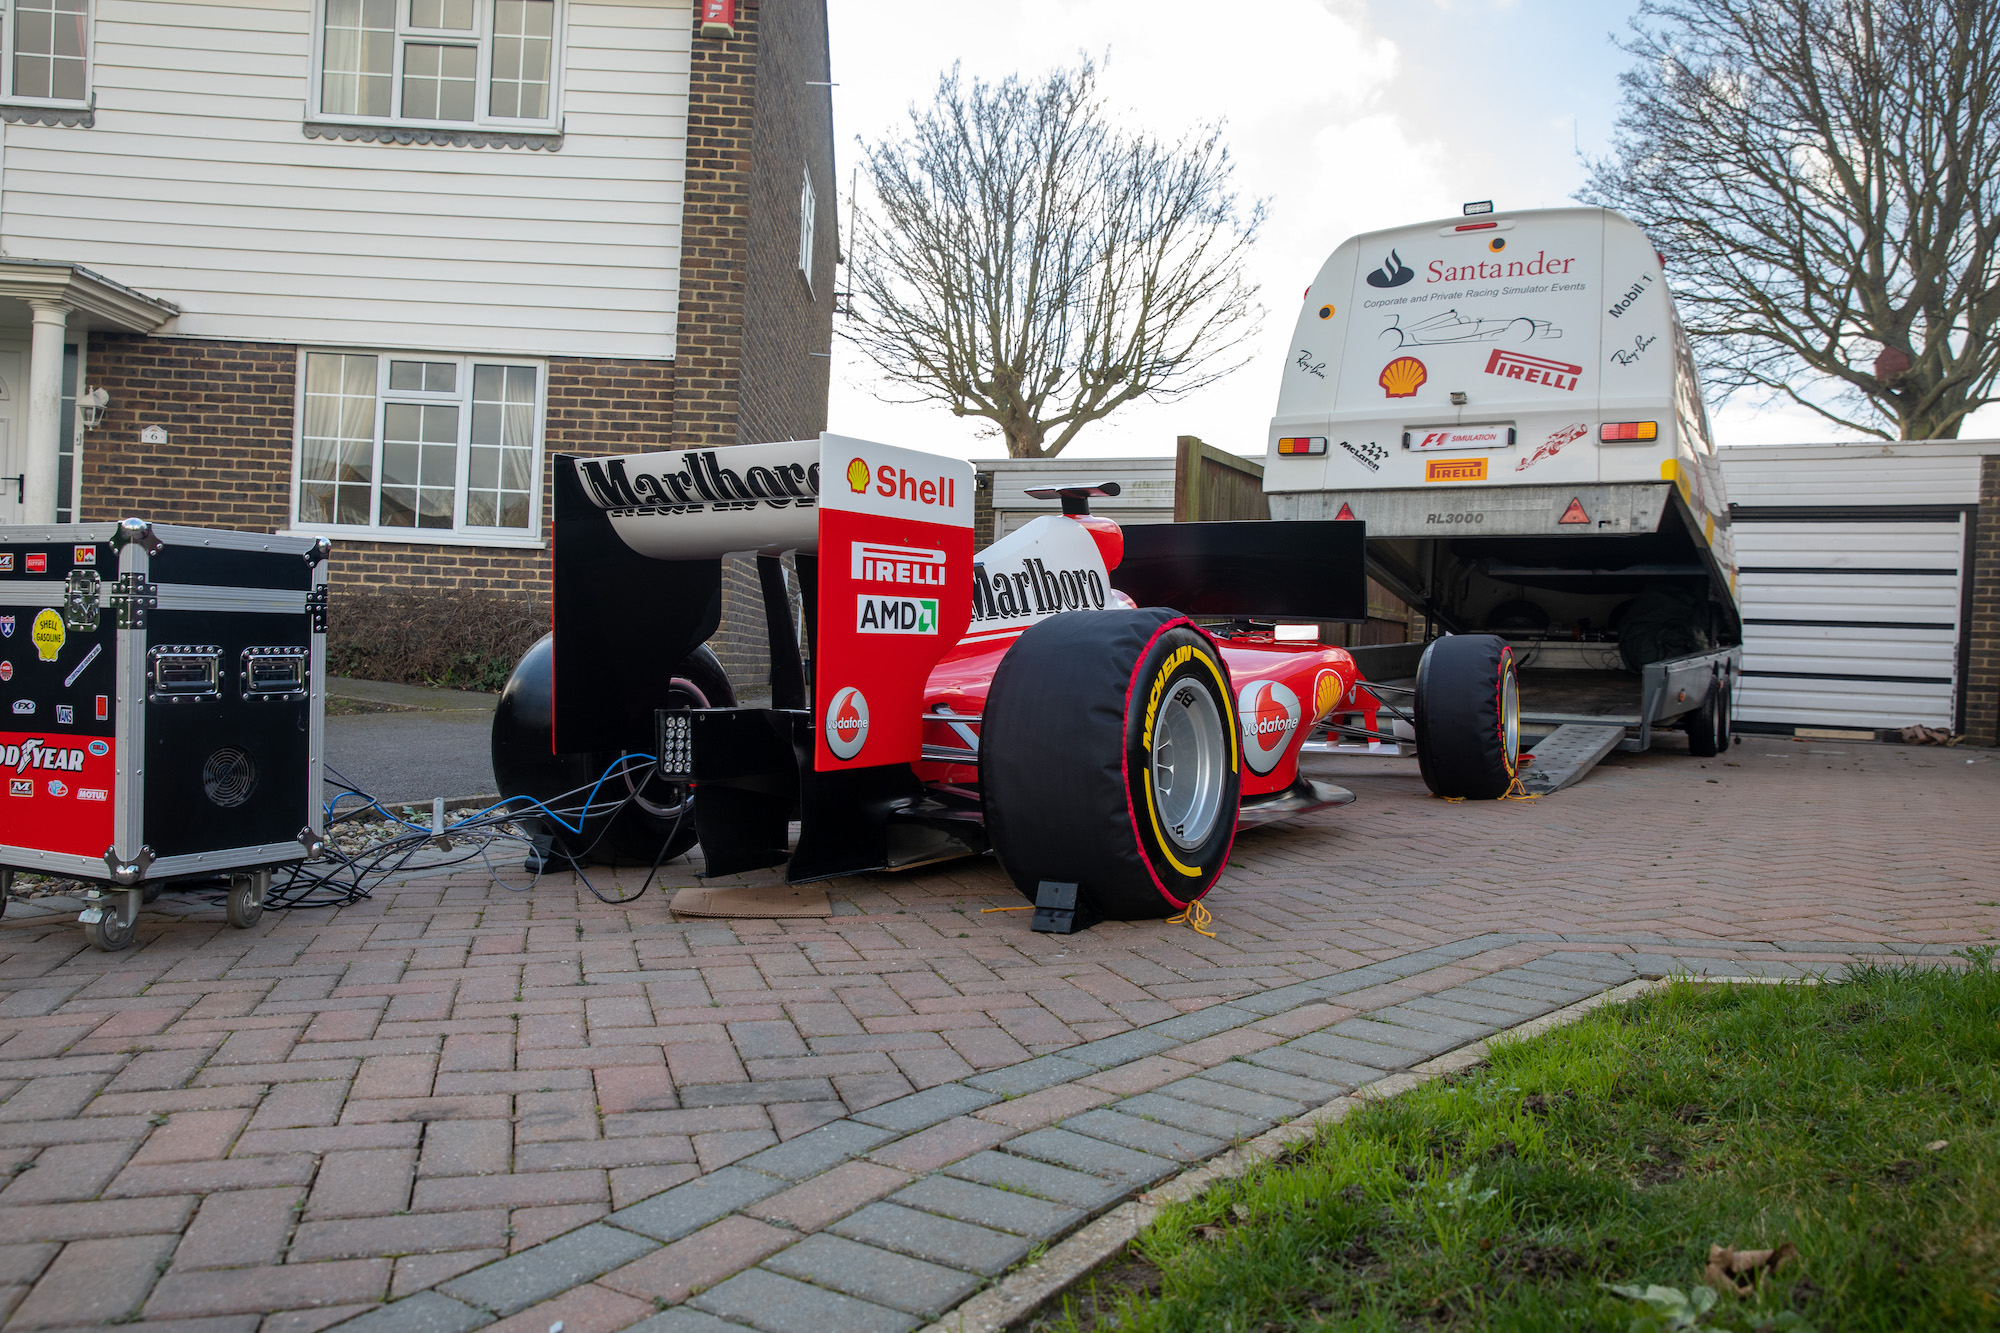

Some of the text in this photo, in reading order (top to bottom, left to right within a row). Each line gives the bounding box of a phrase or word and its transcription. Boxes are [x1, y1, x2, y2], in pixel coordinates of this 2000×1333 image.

[1426, 251, 1576, 283] Santander
[1363, 282, 1586, 309] Corporate and Private Racing Simulator Events
[1608, 283, 1645, 318] Mobil
[1484, 348, 1582, 391] PIRELLI
[151, 433, 158, 441] 6
[1420, 433, 1497, 447] F1 SIMULATION
[1340, 441, 1380, 471] McLaren
[1429, 461, 1482, 479] PIRELLI
[877, 465, 954, 508] Shell
[1426, 513, 1484, 524] RL3000
[851, 541, 947, 585] PIRELLI
[860, 600, 916, 629] AMD
[40, 620, 57, 631] SHELL
[36, 633, 61, 643] GASOLINE
[18, 702, 31, 710] FX
[1142, 645, 1192, 752] MICHELIN
[57, 705, 73, 723] VANS
[827, 716, 868, 731] vodafone
[1242, 715, 1299, 737] vodafone
[79, 791, 106, 799] MOTUL
